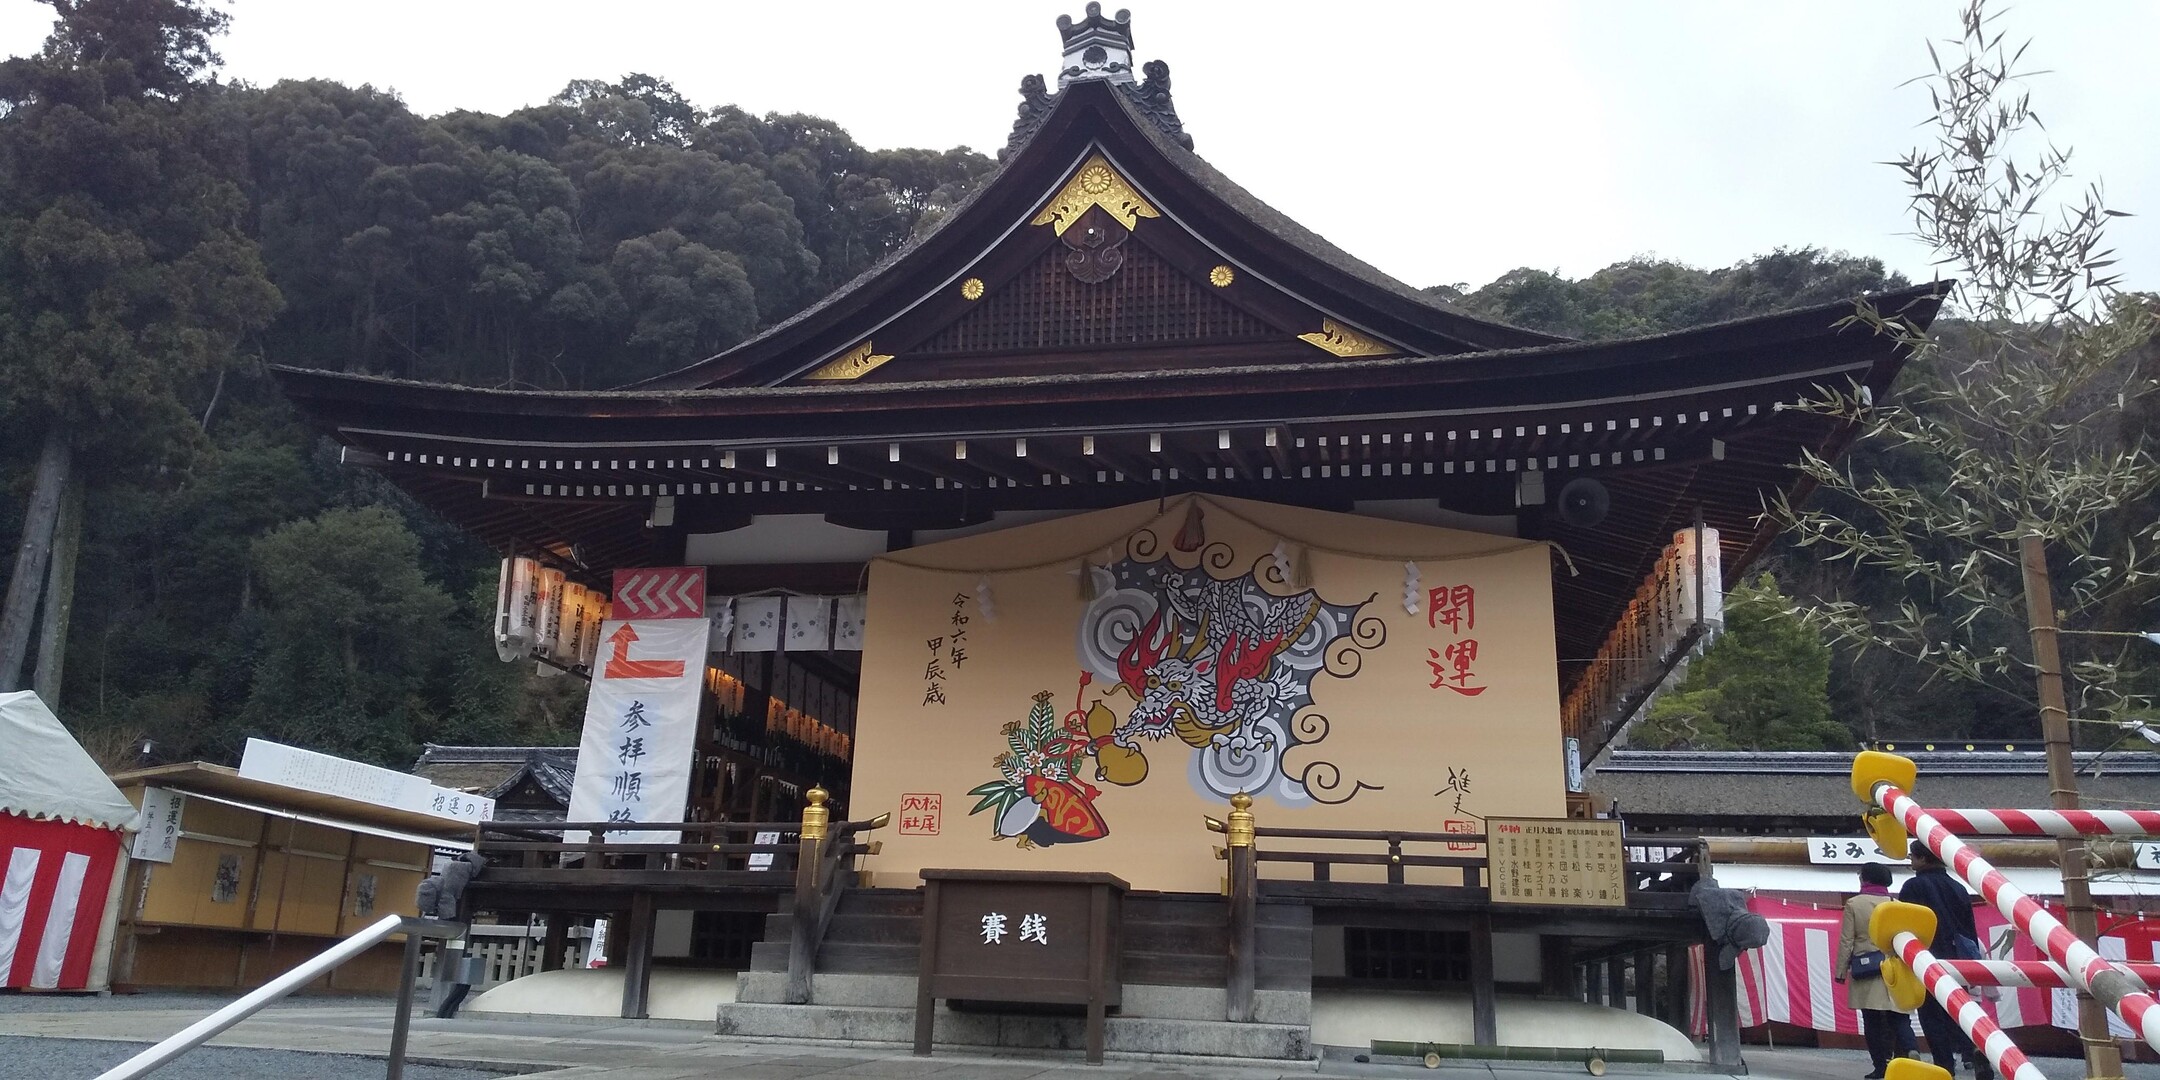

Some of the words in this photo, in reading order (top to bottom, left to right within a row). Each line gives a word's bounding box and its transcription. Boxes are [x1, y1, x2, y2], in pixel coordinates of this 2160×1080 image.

[950, 592, 971, 670] 令和六年
[1426, 584, 1488, 697] 開運
[922, 636, 947, 707] 甲辰歳
[606, 700, 652, 836] 参拝順路
[162, 795, 182, 850] 招運の辰
[432, 793, 489, 820] 招運の辰
[1498, 824, 1521, 834] 奉納
[1525, 826, 1563, 835] 正月大絵馬
[979, 911, 1048, 946] 賽銭
